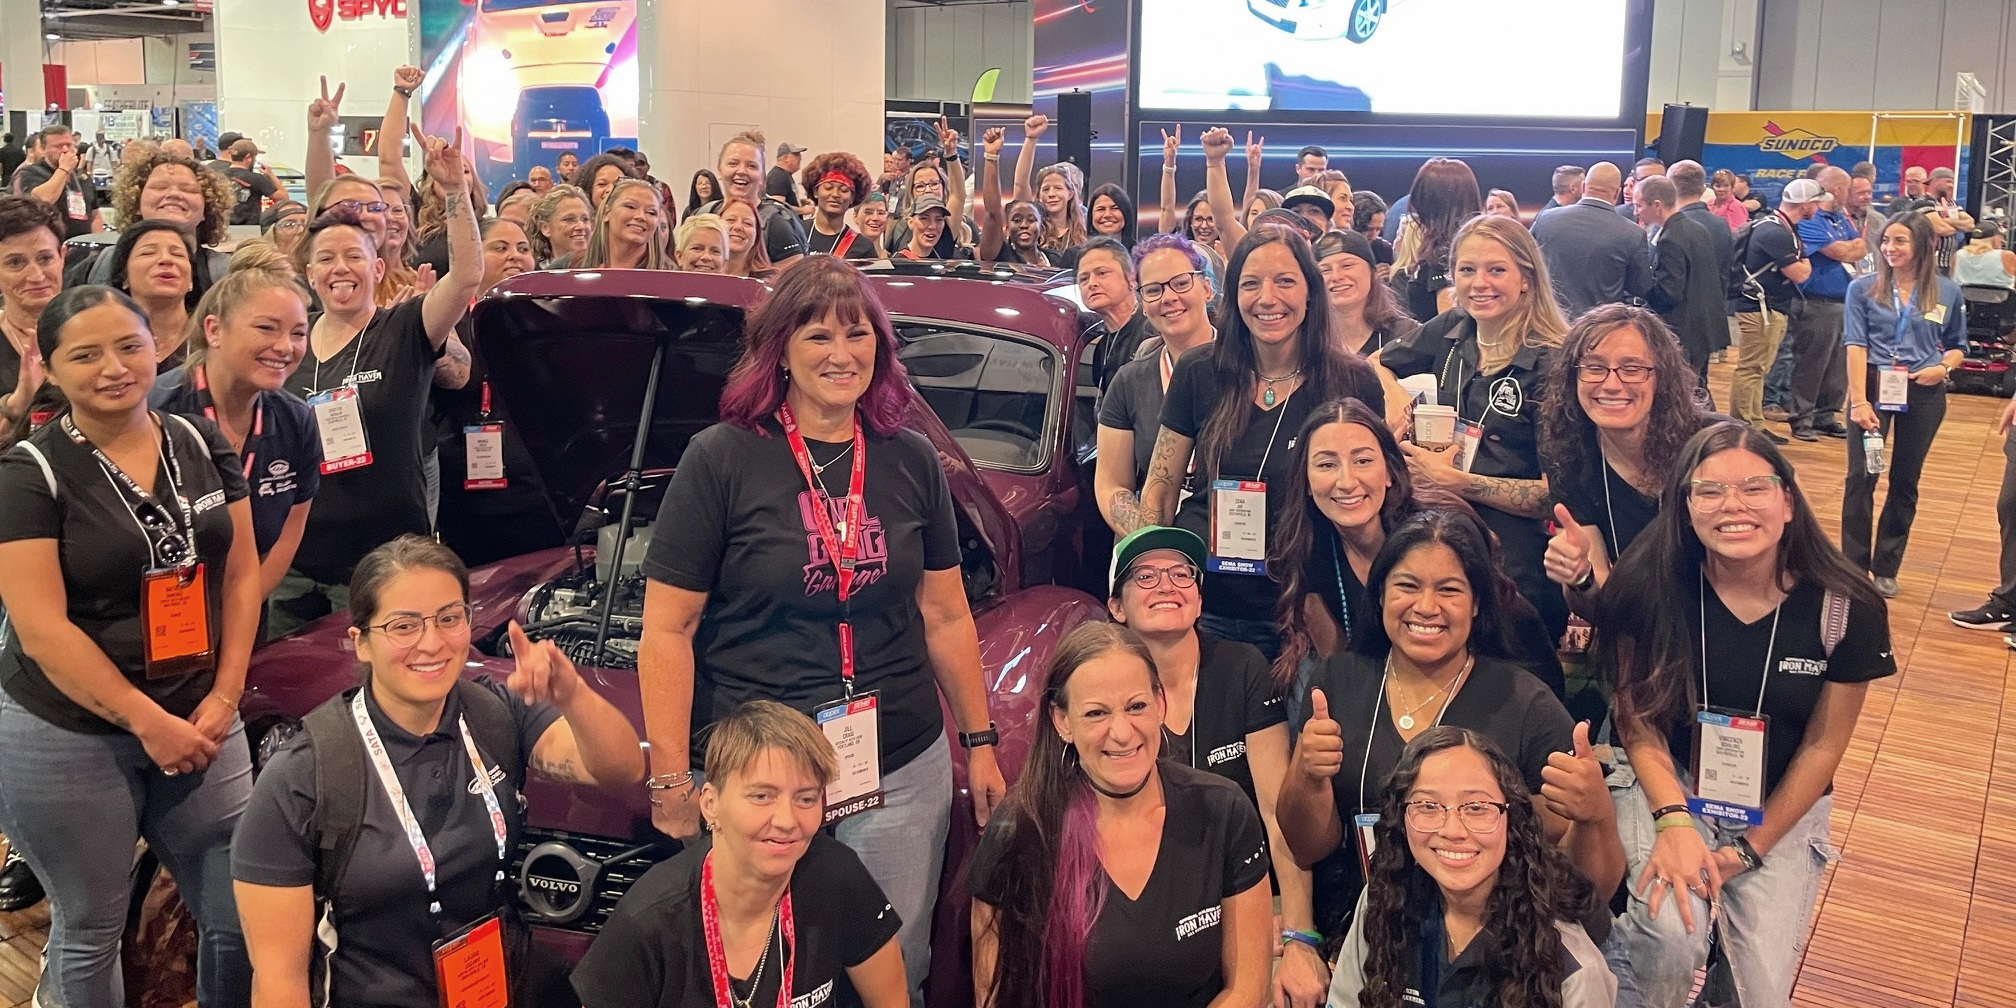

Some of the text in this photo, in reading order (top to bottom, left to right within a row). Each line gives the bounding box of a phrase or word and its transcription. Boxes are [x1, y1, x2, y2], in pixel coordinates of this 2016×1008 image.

[1763, 139, 1834, 150] SUNOCO
[1755, 168, 1796, 178] RACE
[326, 456, 367, 471] BUYER-22
[846, 503, 858, 548] SPYDER
[365, 729, 383, 756] SATA
[825, 795, 880, 822] SPOUSE-22
[528, 877, 578, 893] VOLVO
[1175, 918, 1198, 941] IRON
